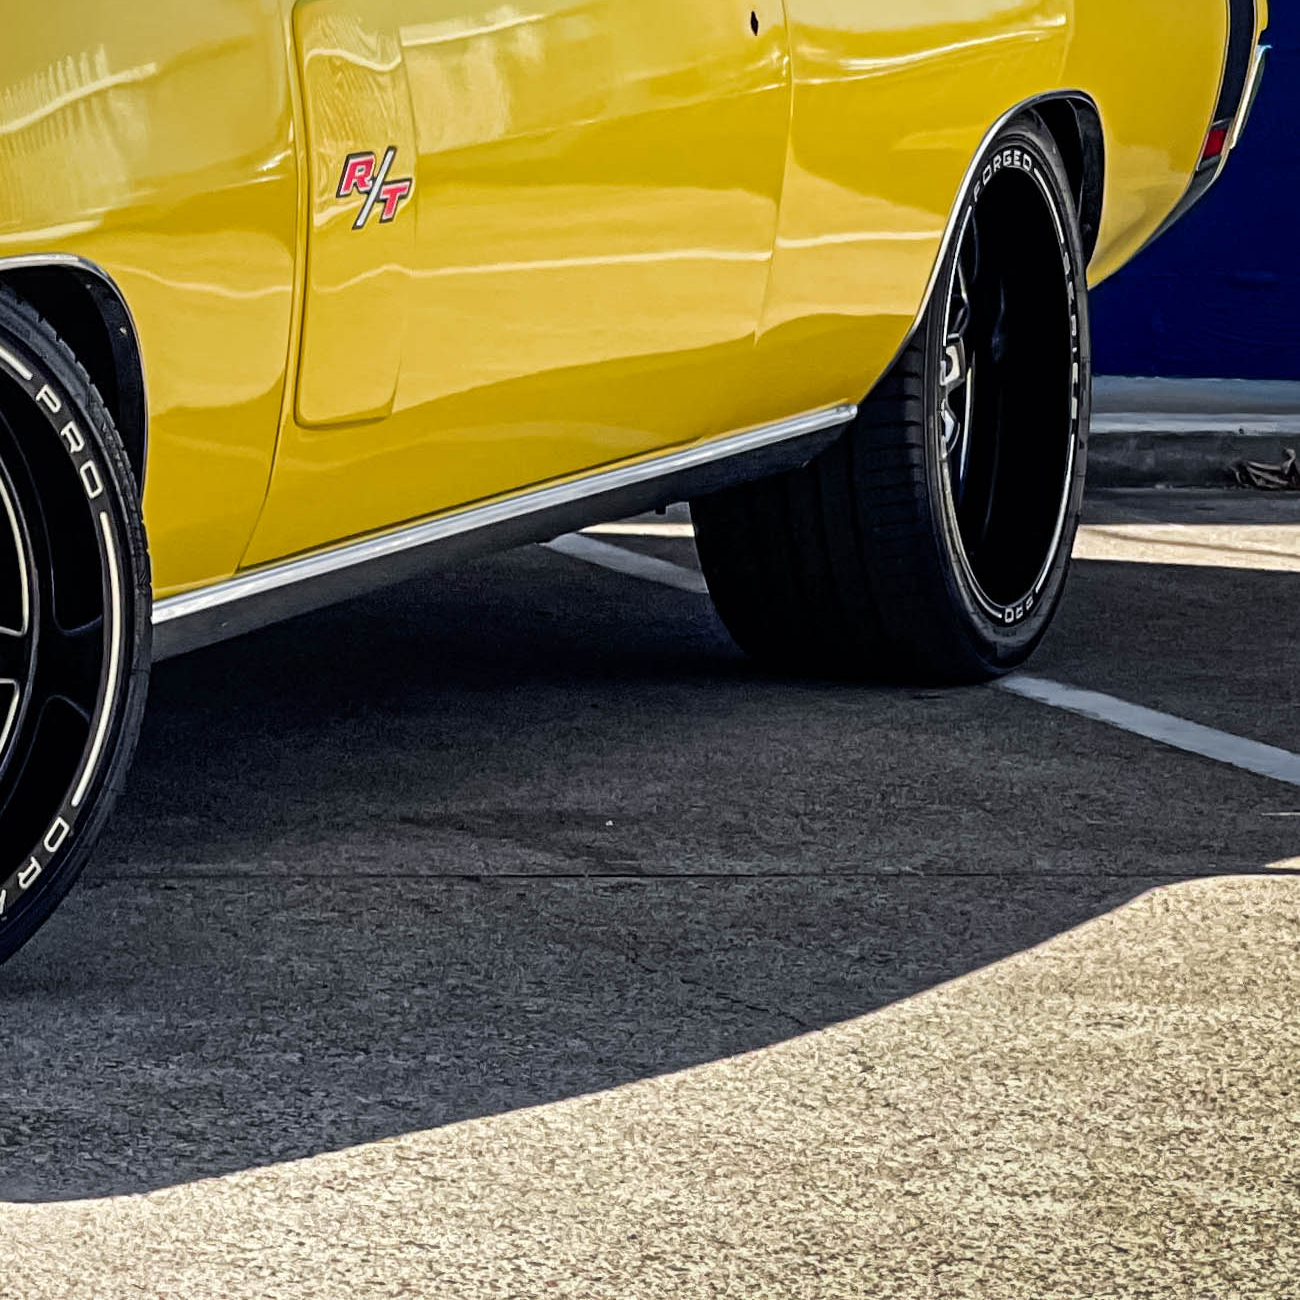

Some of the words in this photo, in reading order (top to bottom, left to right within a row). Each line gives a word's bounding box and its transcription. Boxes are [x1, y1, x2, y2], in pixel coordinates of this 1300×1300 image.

[336, 145, 413, 230] R/T
[973, 149, 1032, 203] FORGED
[35, 384, 104, 500] PRO
